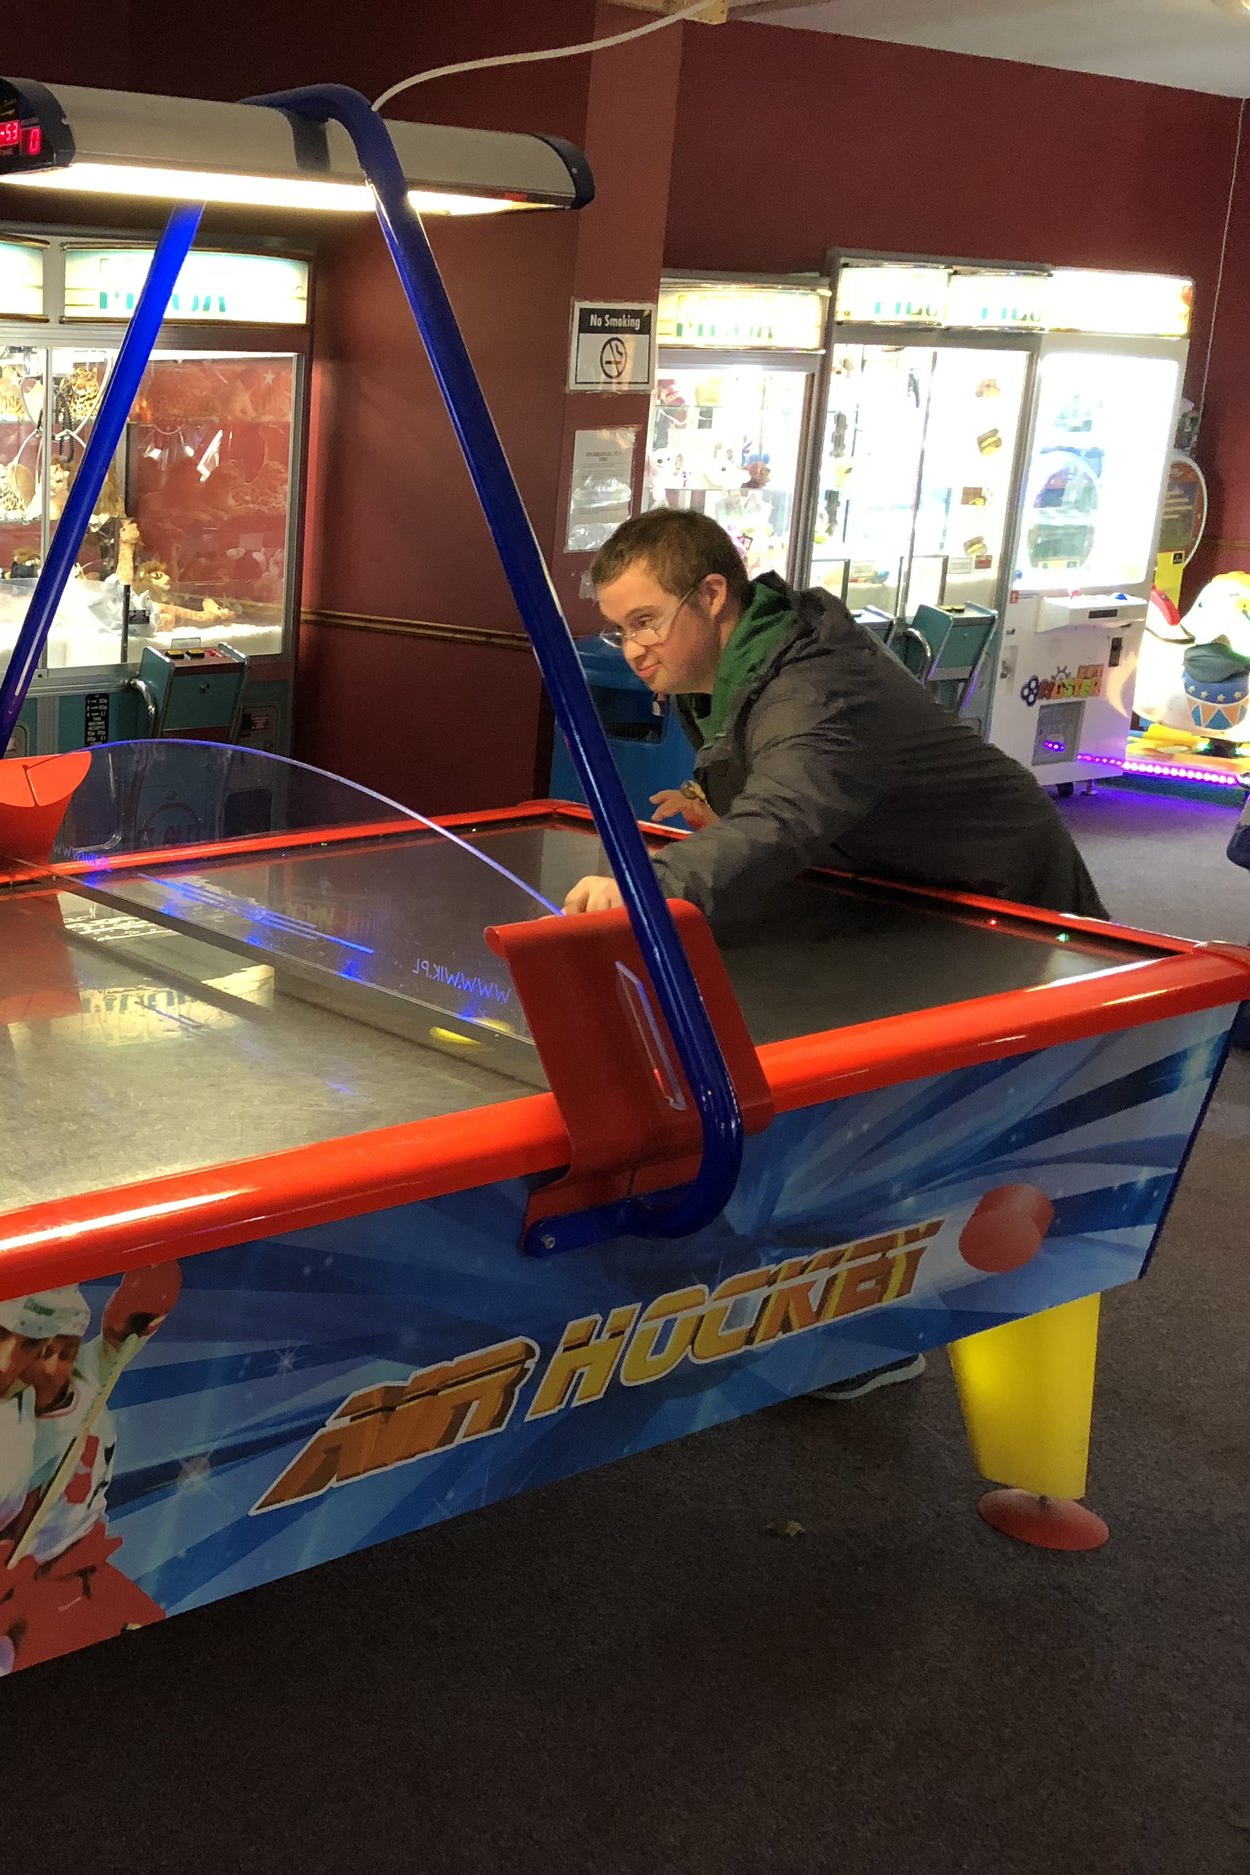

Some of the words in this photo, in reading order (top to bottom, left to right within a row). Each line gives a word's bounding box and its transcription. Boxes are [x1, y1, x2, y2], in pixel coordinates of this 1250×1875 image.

[590, 314, 602, 327] No
[604, 314, 640, 331] Smoking
[250, 1336, 540, 1516] AIR
[524, 1219, 946, 1421] HOCKEY
